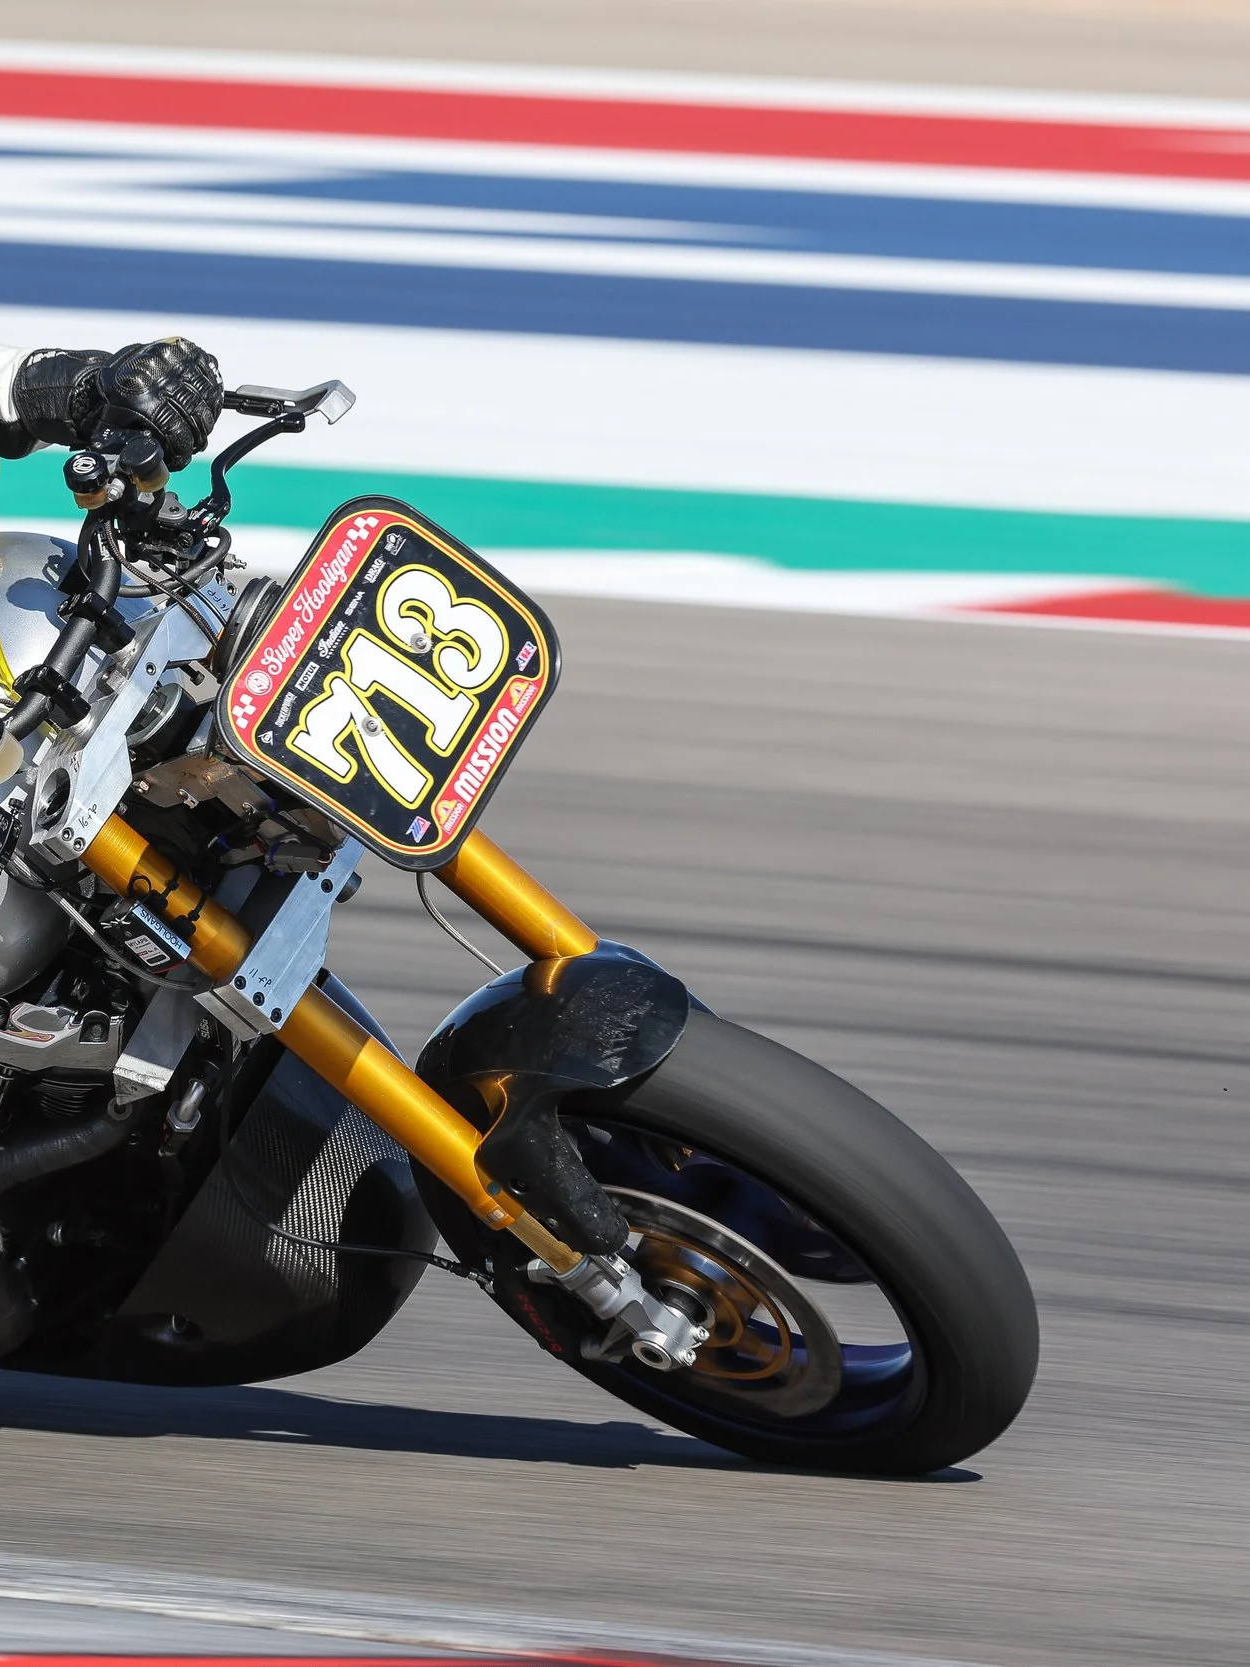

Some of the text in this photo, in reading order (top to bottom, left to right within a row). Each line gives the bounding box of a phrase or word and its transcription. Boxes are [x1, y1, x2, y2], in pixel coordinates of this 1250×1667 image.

[260, 539, 358, 675] Super Hooligan
[344, 591, 366, 616] SENA
[318, 620, 345, 658] Indian
[287, 565, 508, 808] 713
[298, 664, 317, 689] MOTUL
[453, 707, 519, 803] MISSION
[443, 803, 465, 833] MISSION
[139, 908, 183, 950] HOOLIGANS
